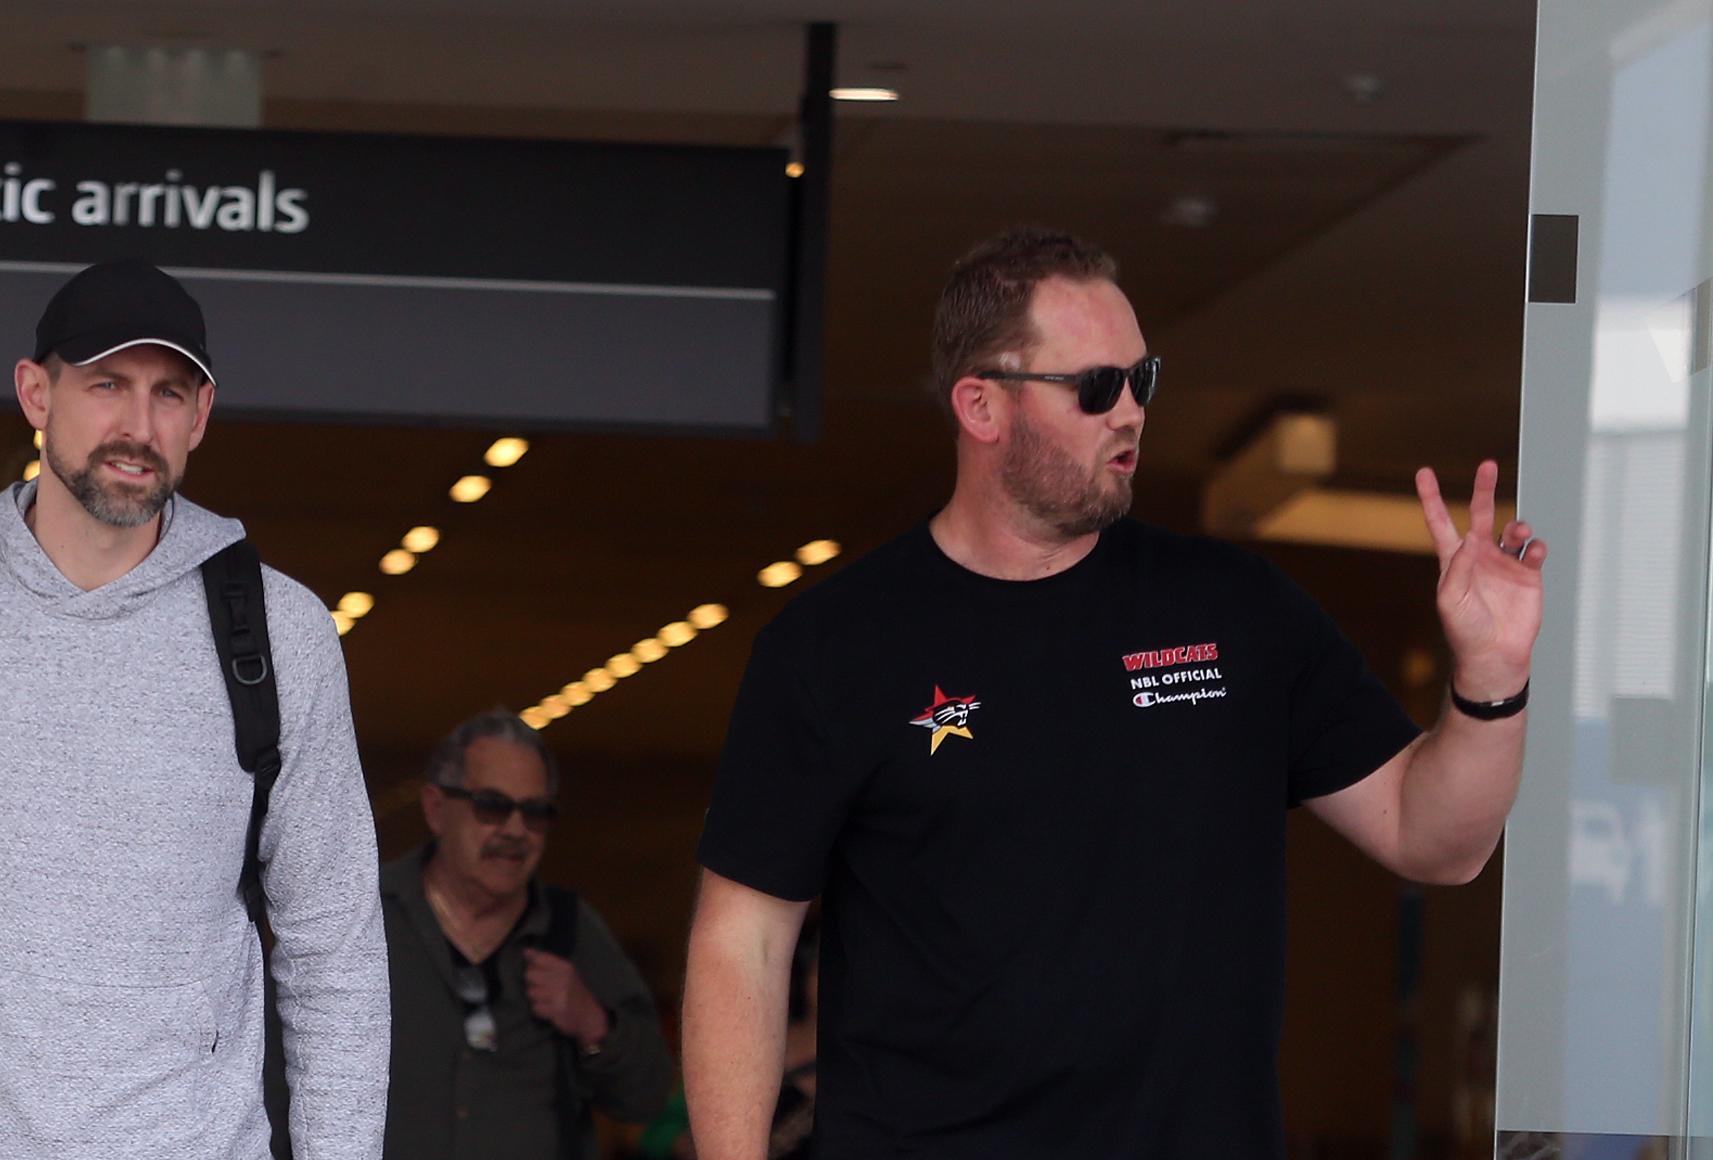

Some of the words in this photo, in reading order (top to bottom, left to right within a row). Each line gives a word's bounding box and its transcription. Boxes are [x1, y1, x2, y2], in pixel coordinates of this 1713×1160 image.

[71, 168, 310, 234] arrivals
[1121, 643, 1218, 671] WILDCATS
[1130, 676, 1160, 690] NBL
[1161, 667, 1223, 685] OFFICIAL
[1132, 686, 1227, 708] Champion
